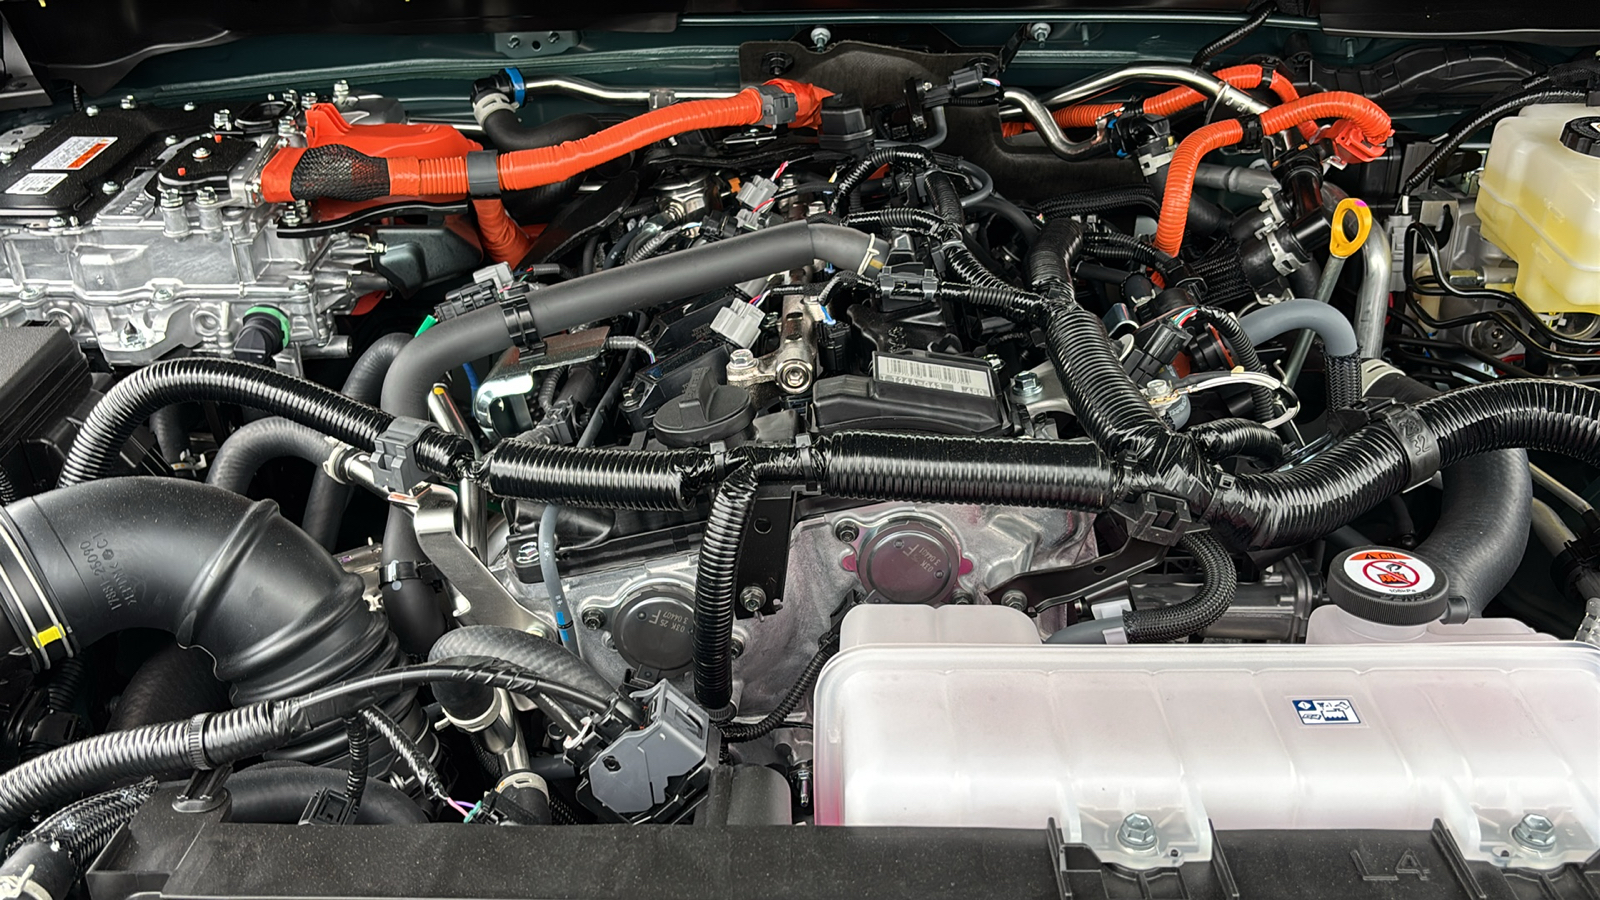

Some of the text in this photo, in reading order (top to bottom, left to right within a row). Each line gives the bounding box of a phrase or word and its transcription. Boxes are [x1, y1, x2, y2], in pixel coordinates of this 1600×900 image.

[902, 543, 920, 557] F
[648, 609, 662, 625] F
[1350, 848, 1430, 881] L4
